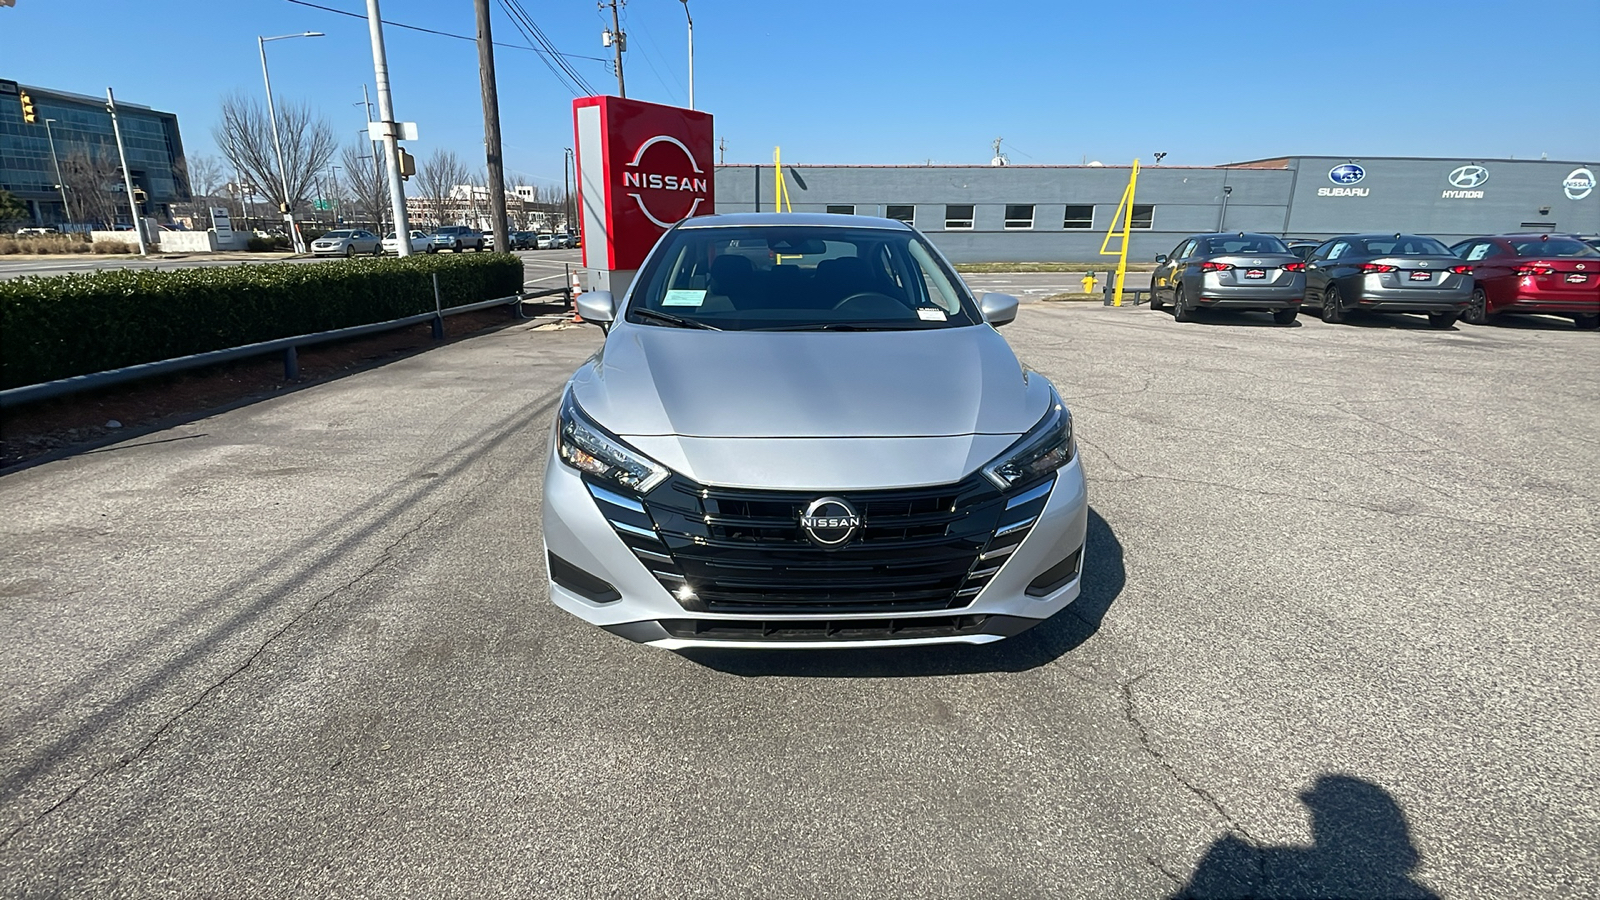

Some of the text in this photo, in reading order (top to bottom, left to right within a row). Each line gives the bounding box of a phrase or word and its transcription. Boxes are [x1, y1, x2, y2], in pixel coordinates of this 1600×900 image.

[623, 171, 707, 193] NISSAN
[1317, 187, 1370, 197] SUBARU
[1441, 190, 1484, 199] HYUNDAI
[801, 517, 860, 527] NISSAN
